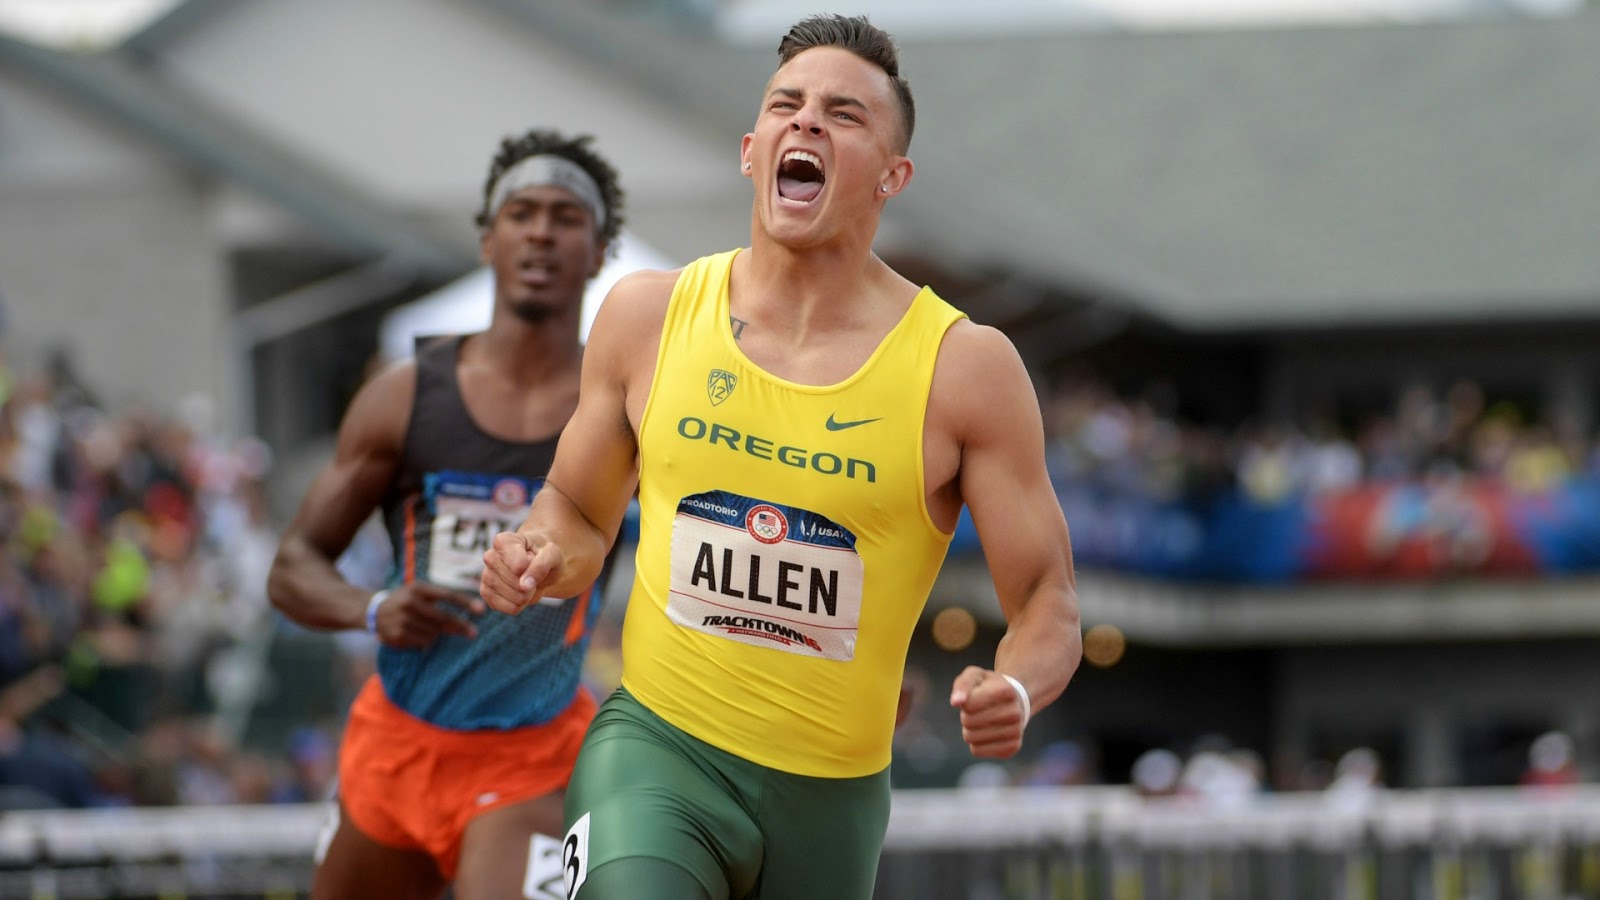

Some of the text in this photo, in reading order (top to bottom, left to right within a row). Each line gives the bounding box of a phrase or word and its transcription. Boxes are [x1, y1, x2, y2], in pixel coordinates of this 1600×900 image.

[709, 371, 736, 394] PAC
[711, 385, 726, 399] 12
[677, 416, 876, 483] OREGON
[681, 499, 738, 517] #ROADTORIO
[691, 541, 838, 617] ALLEN
